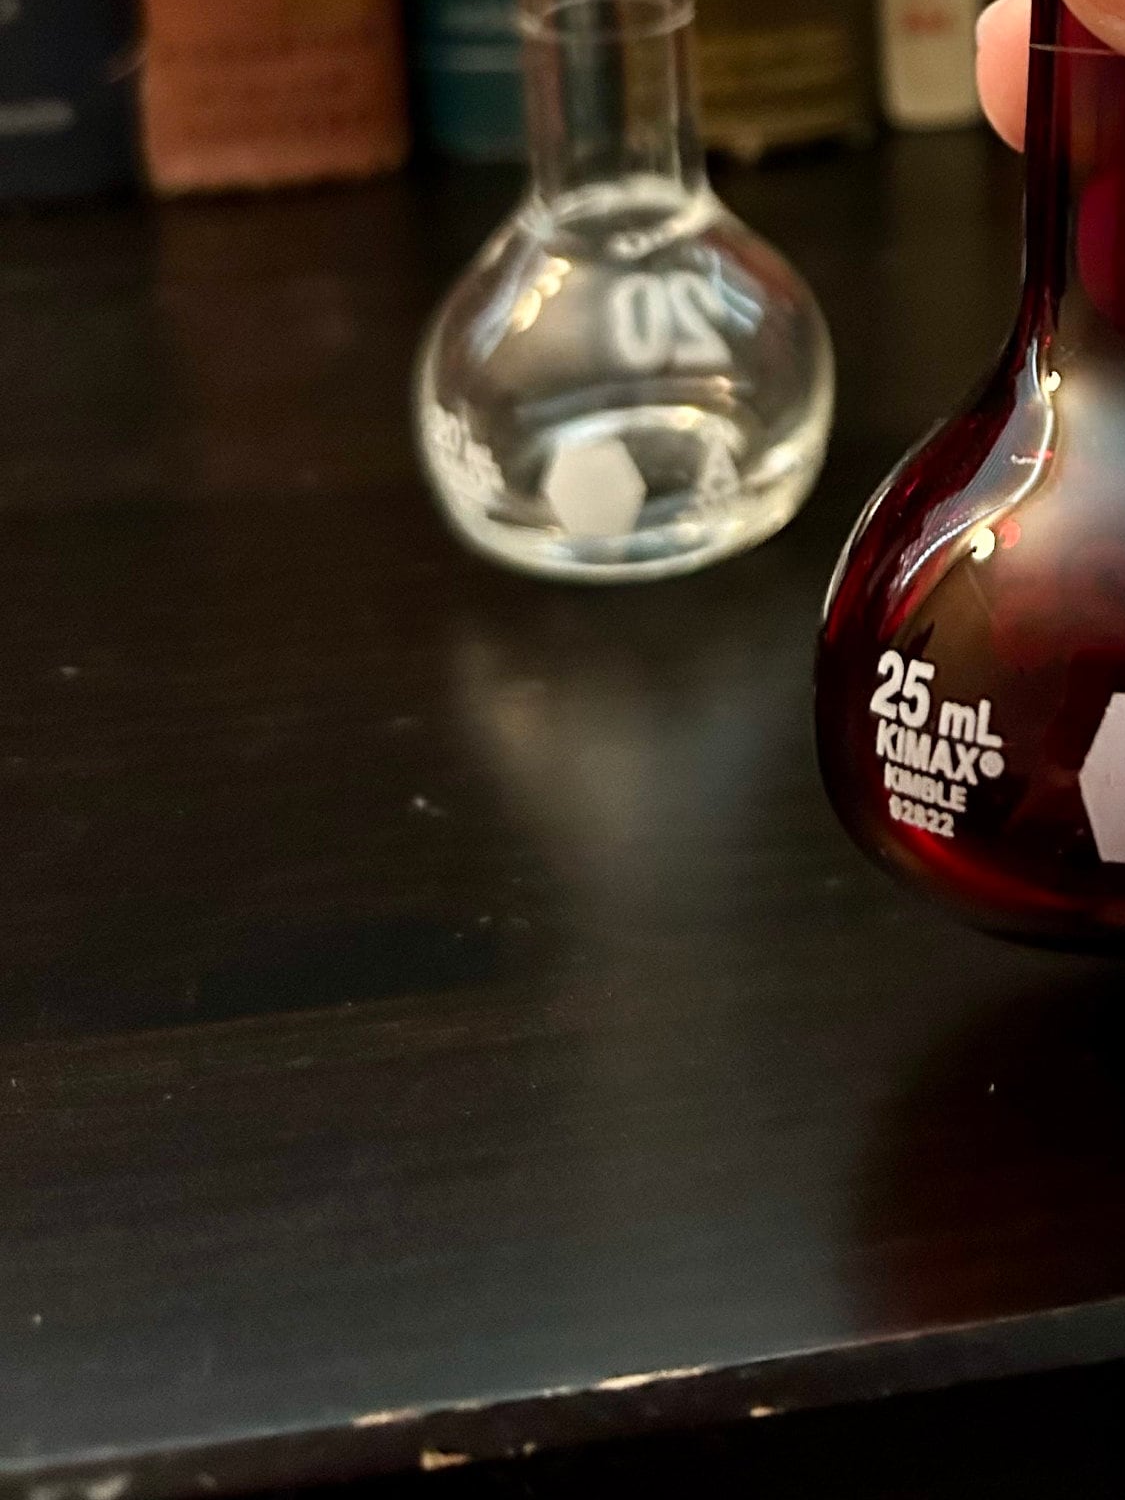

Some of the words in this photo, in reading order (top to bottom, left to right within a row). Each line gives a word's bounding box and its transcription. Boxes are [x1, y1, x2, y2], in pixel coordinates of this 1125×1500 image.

[870, 649, 935, 729] 25
[938, 699, 1003, 749] mL
[884, 761, 968, 813] KIMBLE
